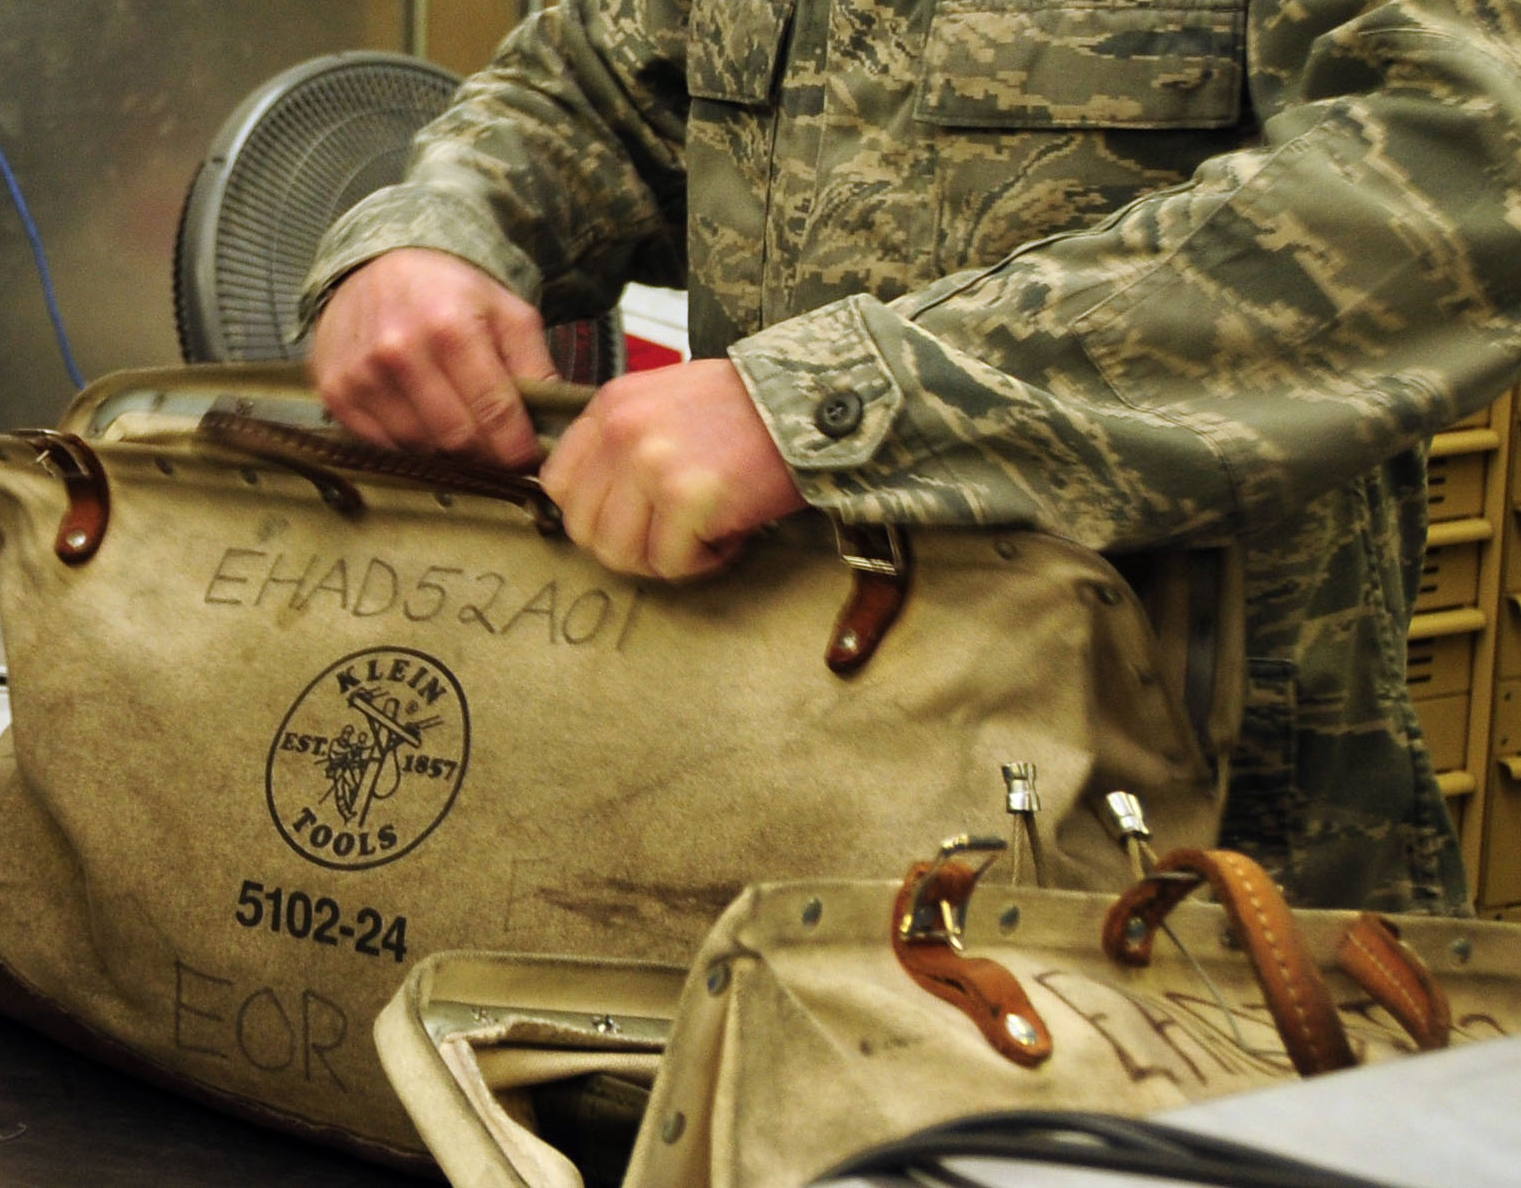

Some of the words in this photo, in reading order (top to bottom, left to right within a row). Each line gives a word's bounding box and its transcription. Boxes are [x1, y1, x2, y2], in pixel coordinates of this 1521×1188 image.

[336, 658, 447, 706] KLEIN
[280, 731, 329, 757] EST.
[402, 754, 458, 781] 1857
[292, 806, 398, 857] TOOLS
[234, 878, 409, 963] 5102-24
